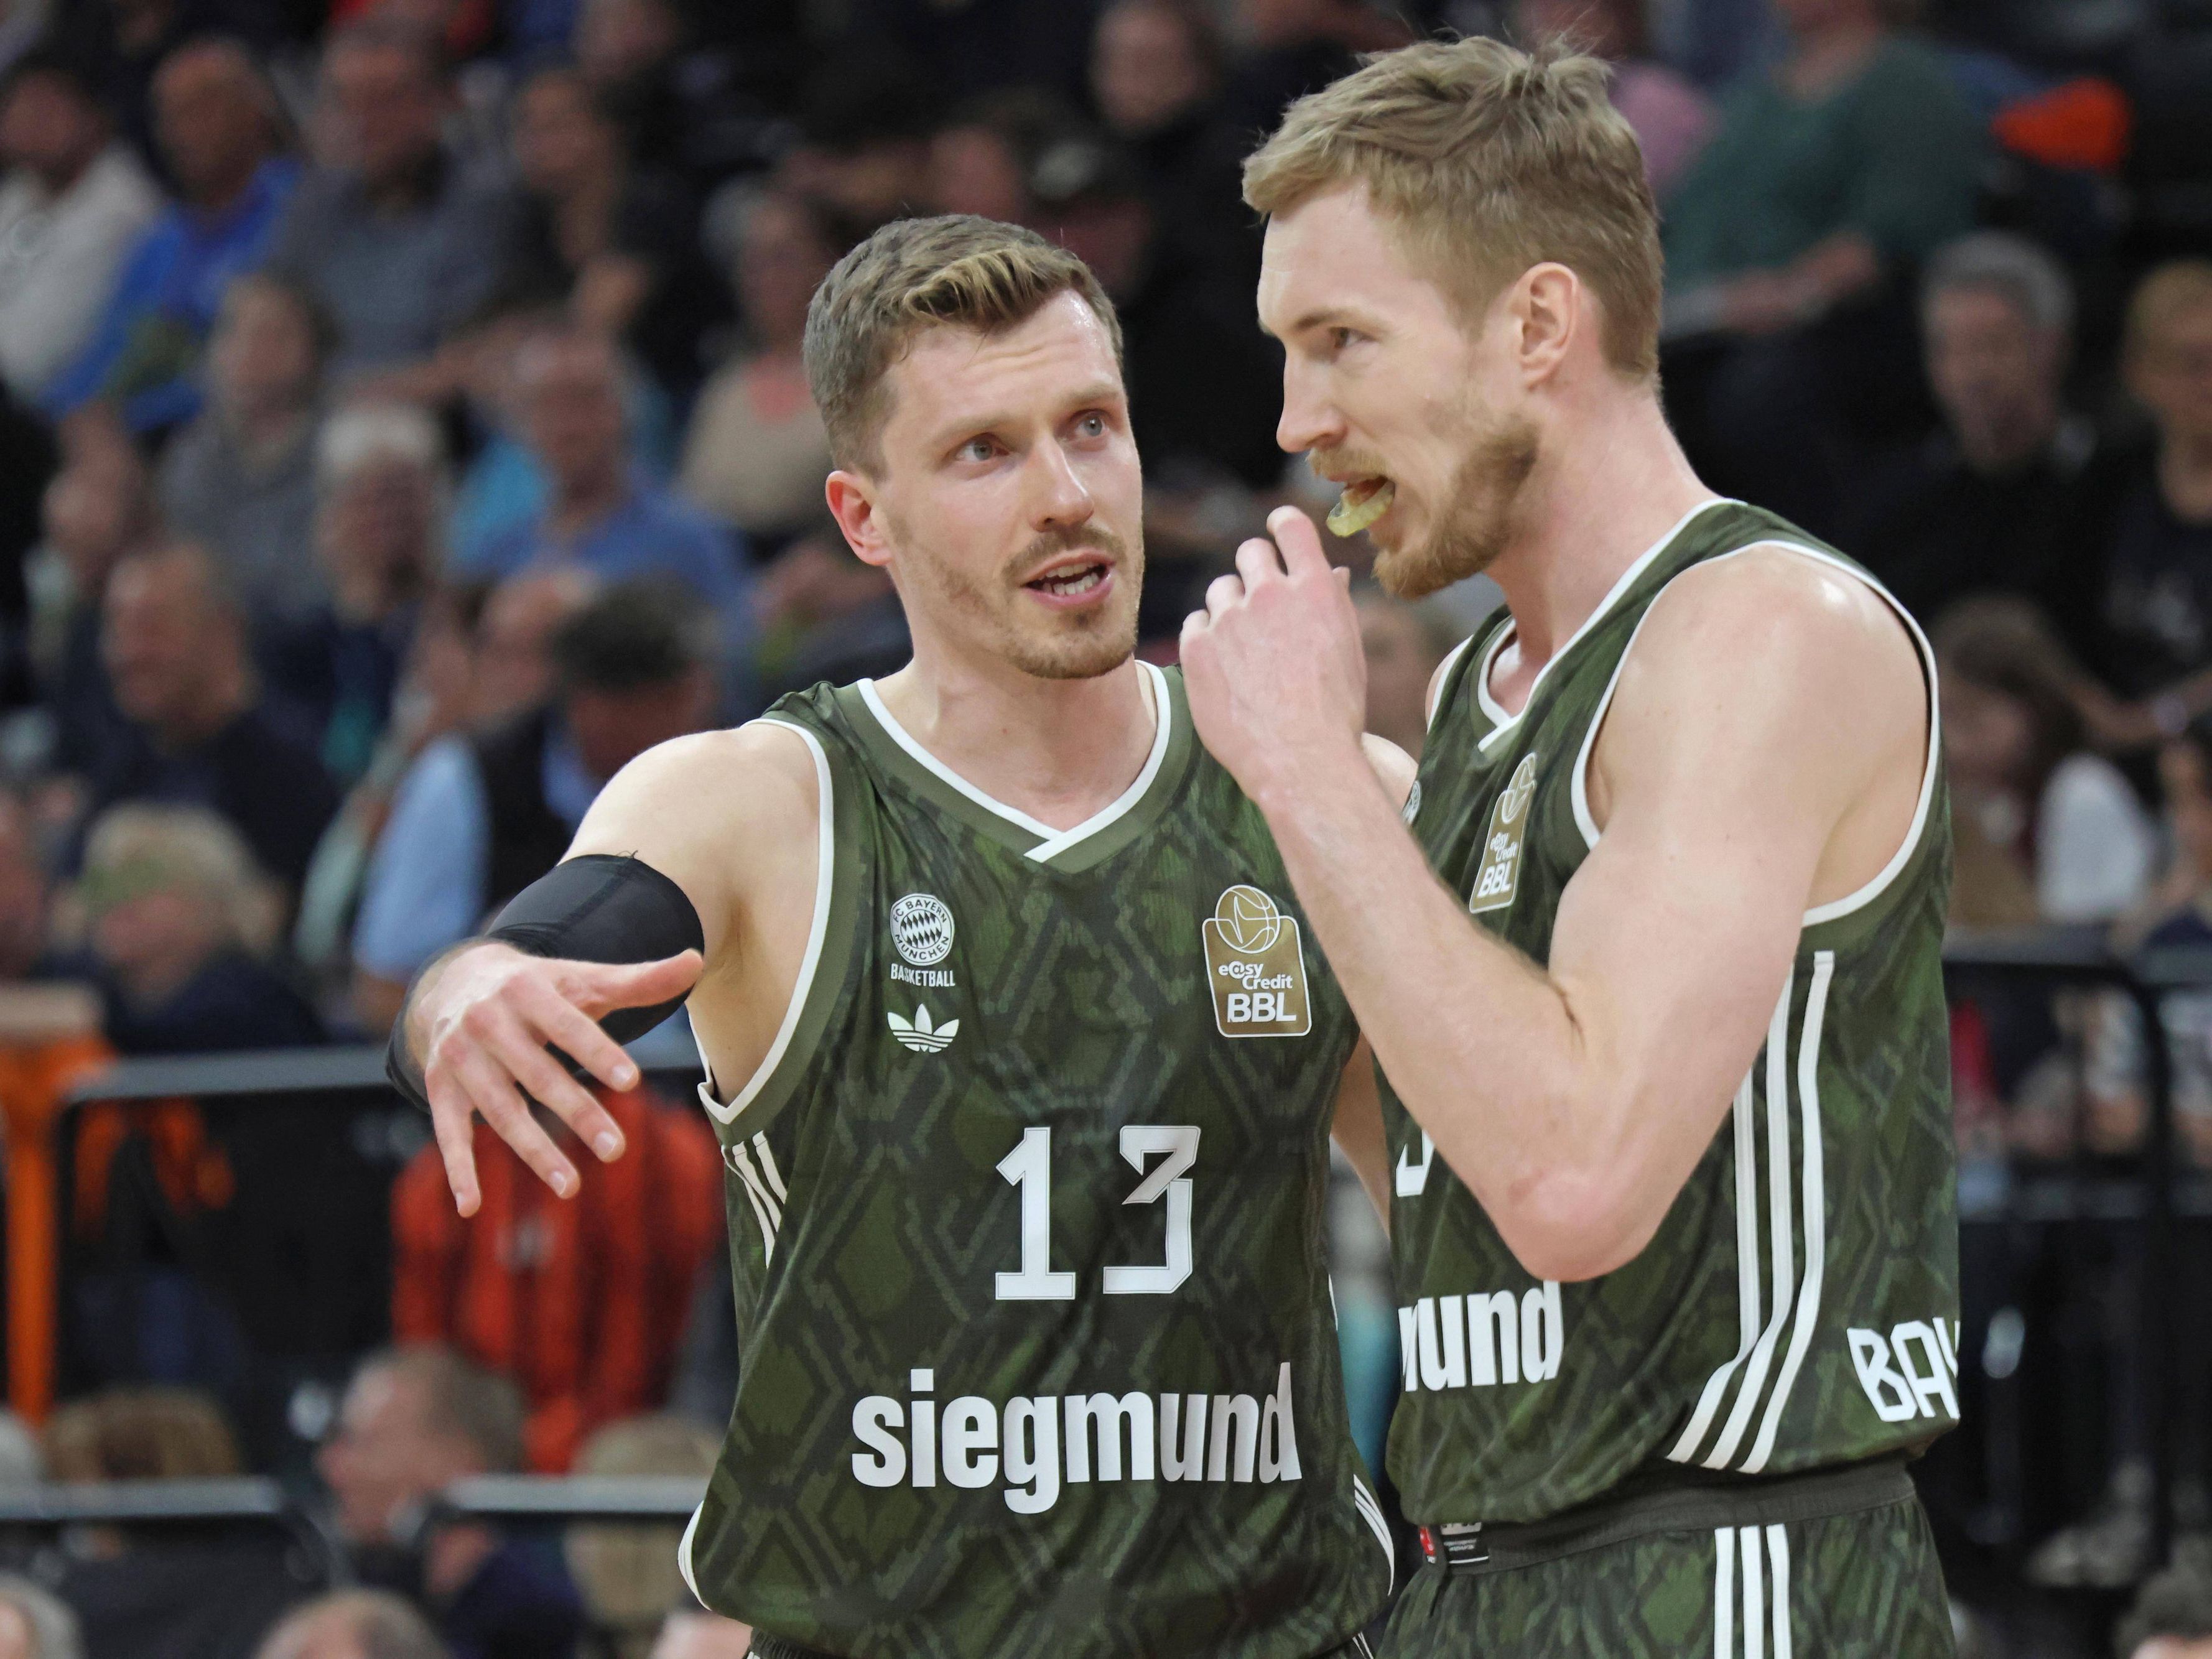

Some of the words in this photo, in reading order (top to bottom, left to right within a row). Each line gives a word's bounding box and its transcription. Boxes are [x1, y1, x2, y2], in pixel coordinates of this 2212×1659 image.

[1477, 860, 1512, 898] BBL
[893, 908, 904, 922] FC
[906, 899, 947, 923] BAYERN
[890, 963, 955, 987] BASKETBALL
[1242, 974, 1293, 990] Credit
[1227, 992, 1297, 1023] BBL
[995, 1125, 1201, 1300] 13
[852, 1362, 1302, 1514] siegmund
